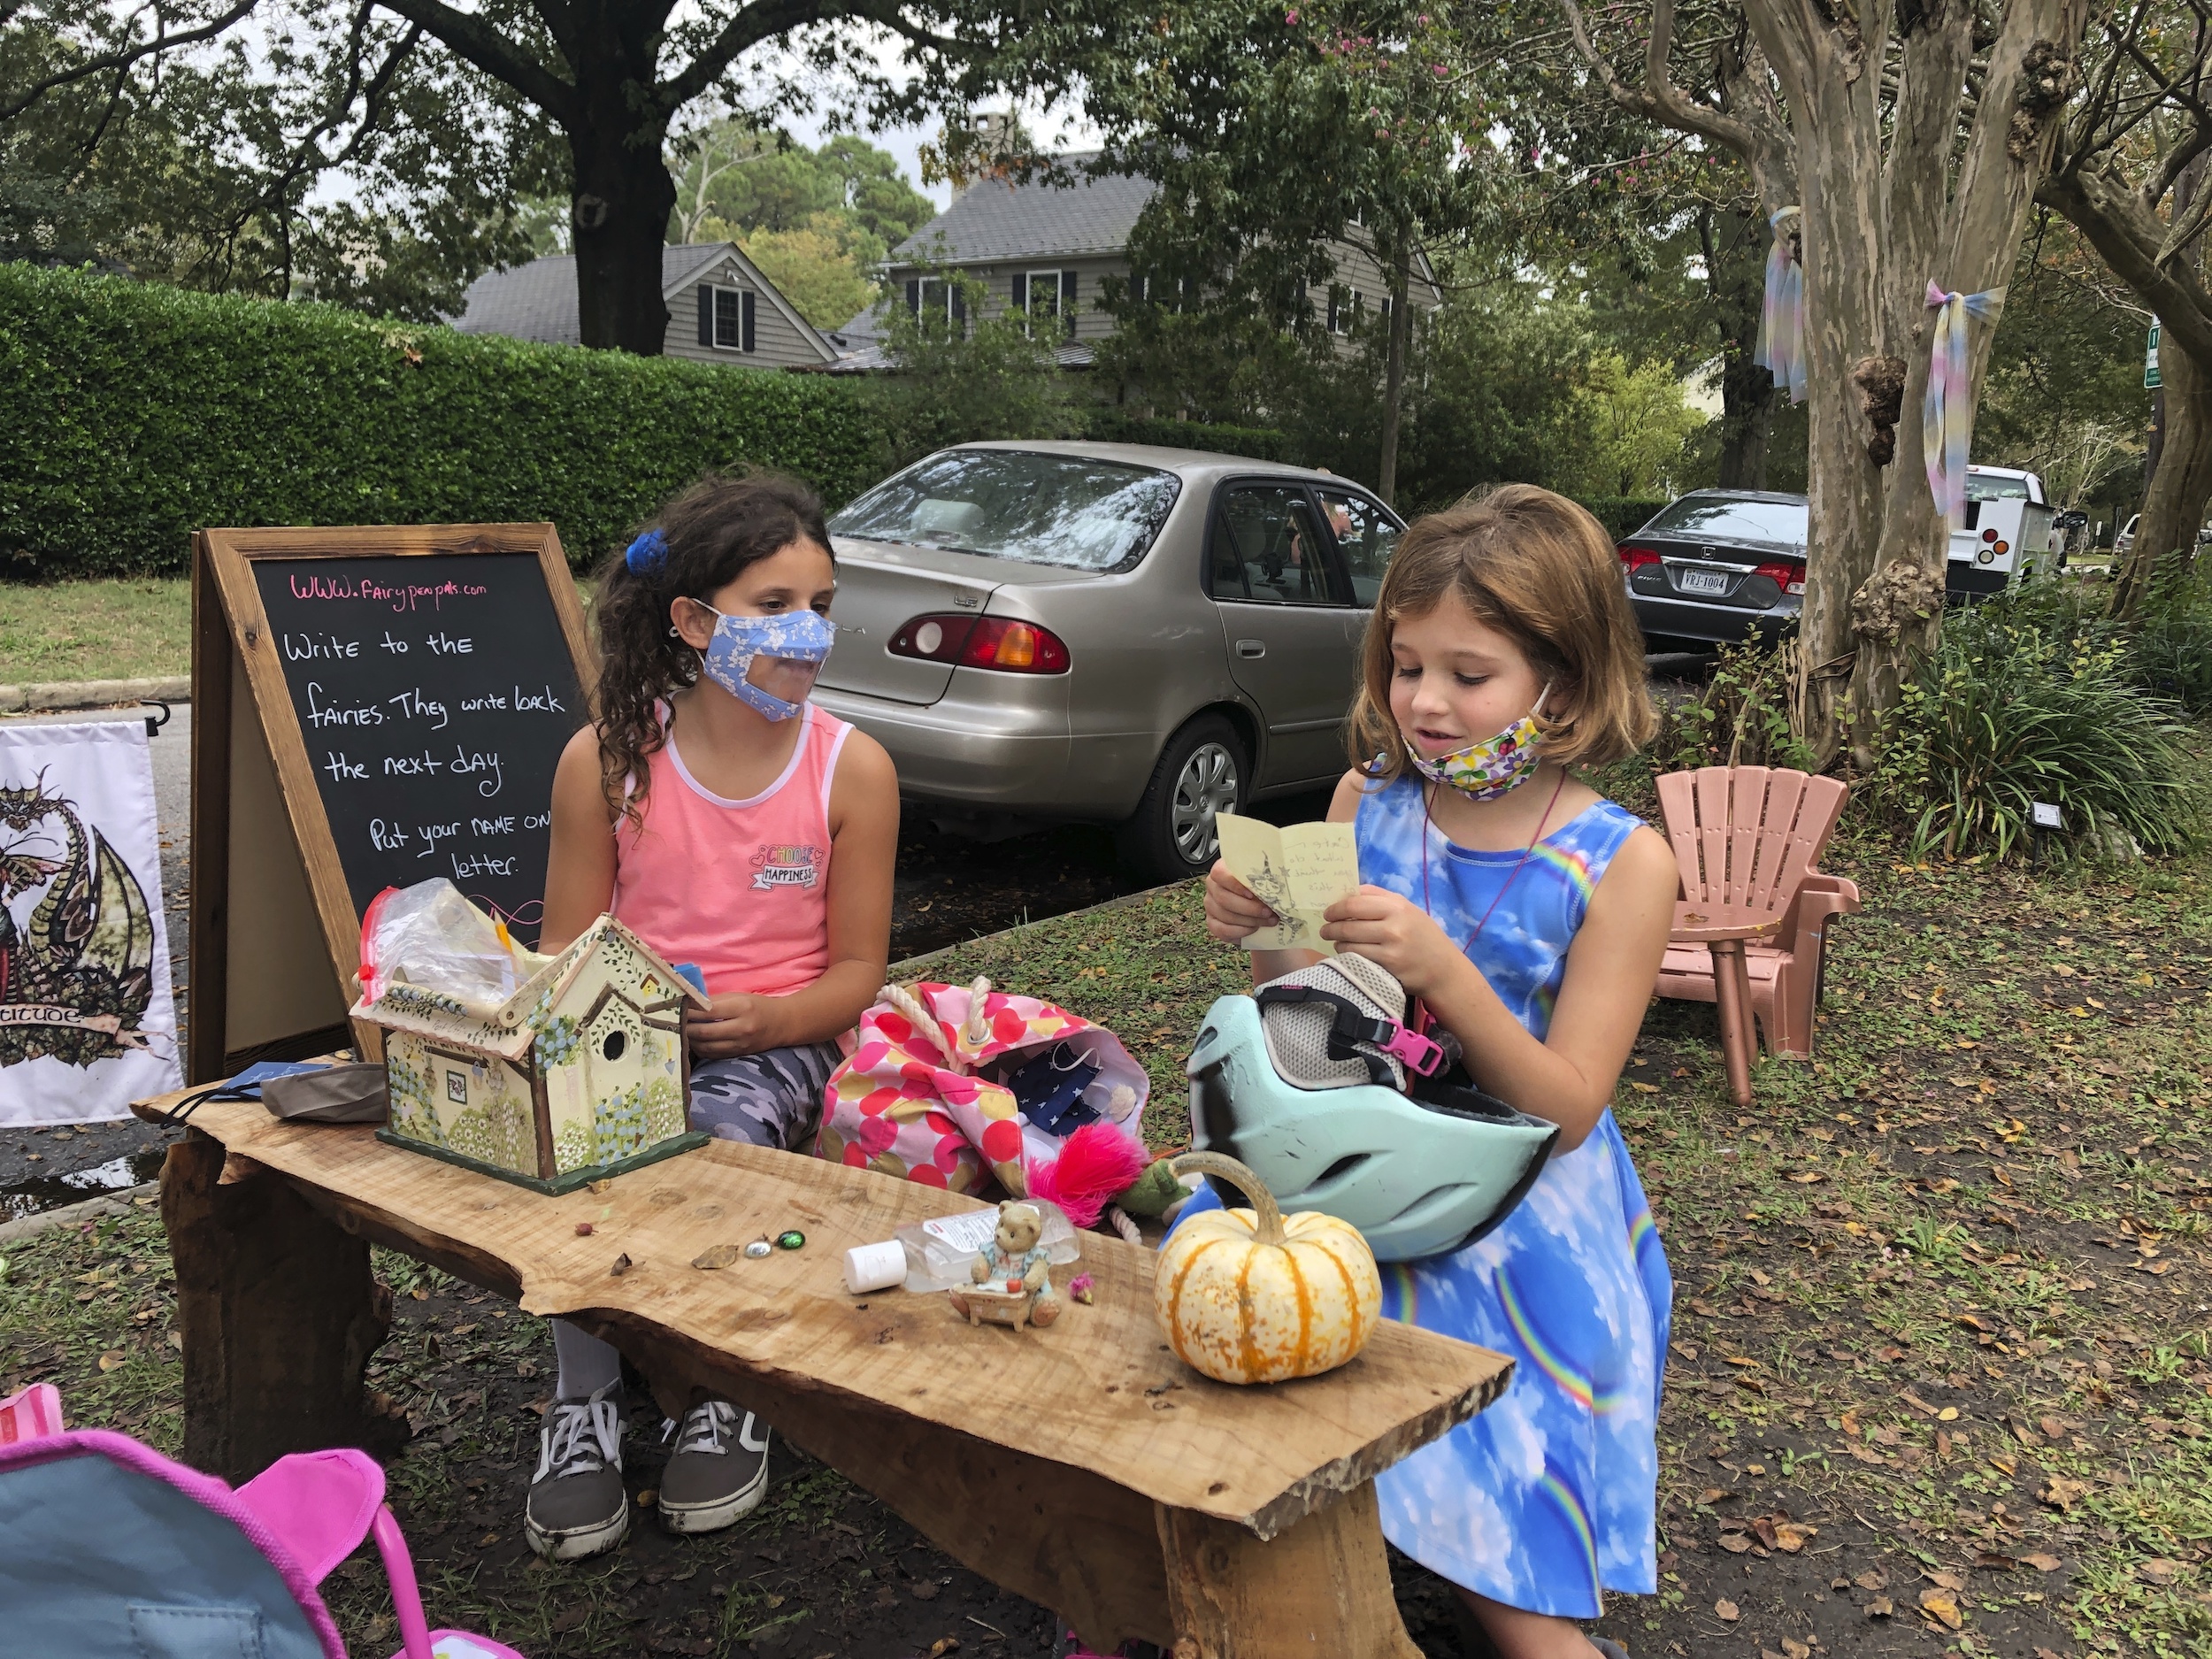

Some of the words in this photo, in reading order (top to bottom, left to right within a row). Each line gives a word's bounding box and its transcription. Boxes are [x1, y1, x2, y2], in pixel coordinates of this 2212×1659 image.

[1686, 573, 1724, 588] VRJ-1004
[954, 595, 978, 608] LE
[380, 632, 408, 655] to
[324, 751, 370, 782] the
[384, 750, 443, 775] next
[370, 818, 410, 851] Put
[417, 822, 461, 858] your
[524, 810, 551, 829] ON
[766, 846, 814, 864] CHOOSE
[451, 853, 519, 879] letter.
[764, 868, 812, 881] HAPPINESS
